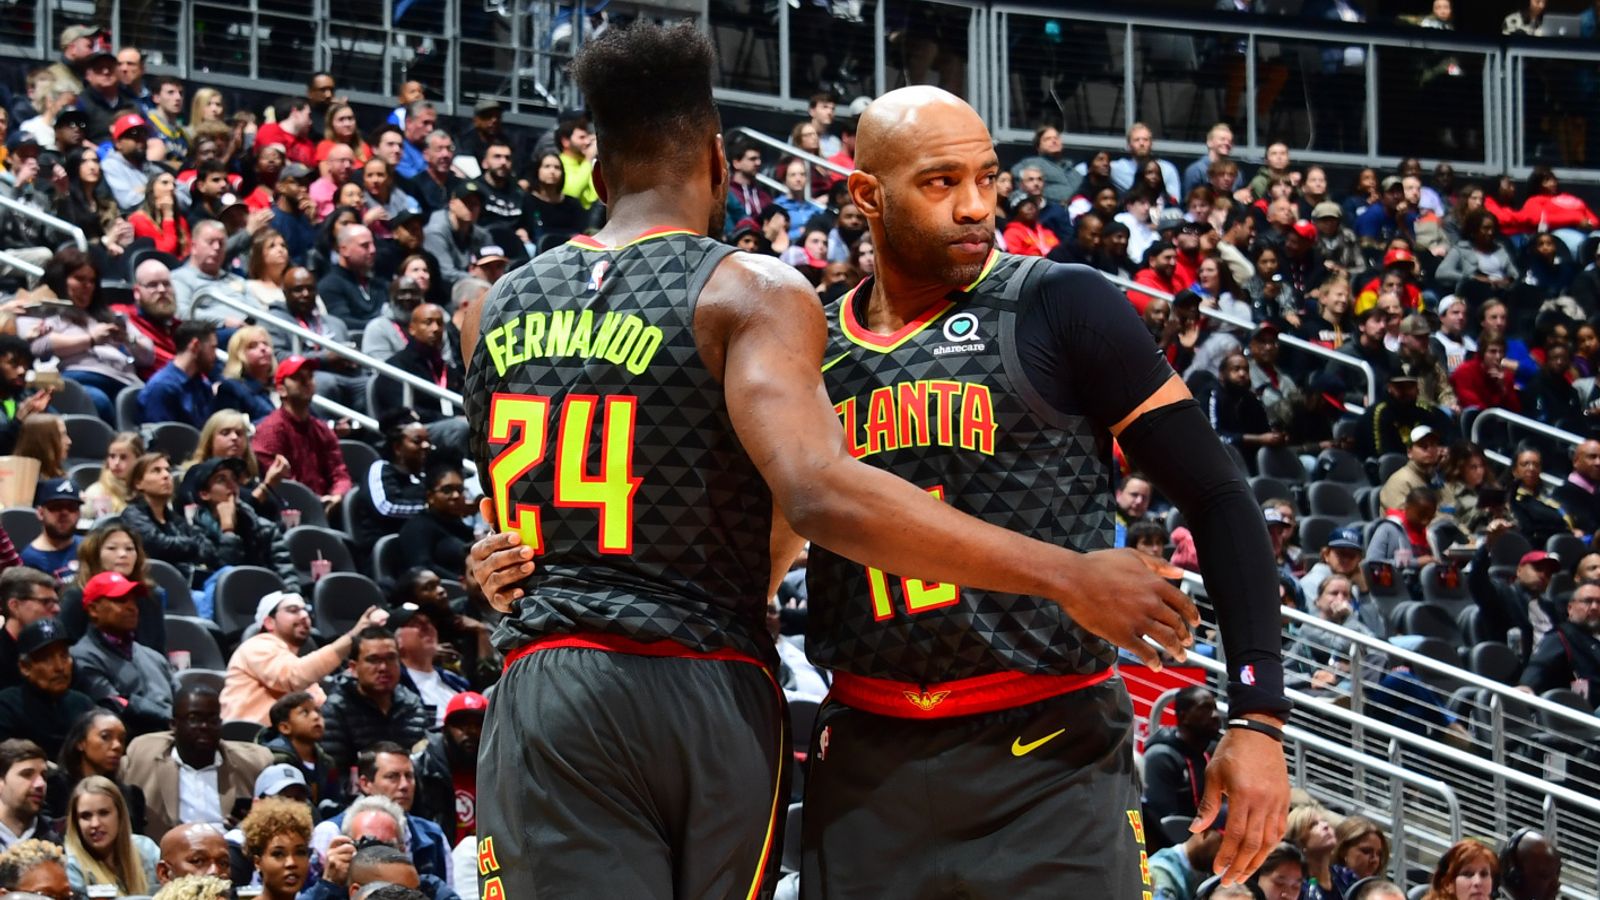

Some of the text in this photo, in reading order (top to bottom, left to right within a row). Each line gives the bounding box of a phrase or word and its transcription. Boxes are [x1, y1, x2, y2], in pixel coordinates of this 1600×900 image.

[485, 310, 663, 377] FERNANDO
[933, 343, 985, 355] sharecare
[833, 379, 998, 460] LANTA
[488, 393, 644, 555] 24
